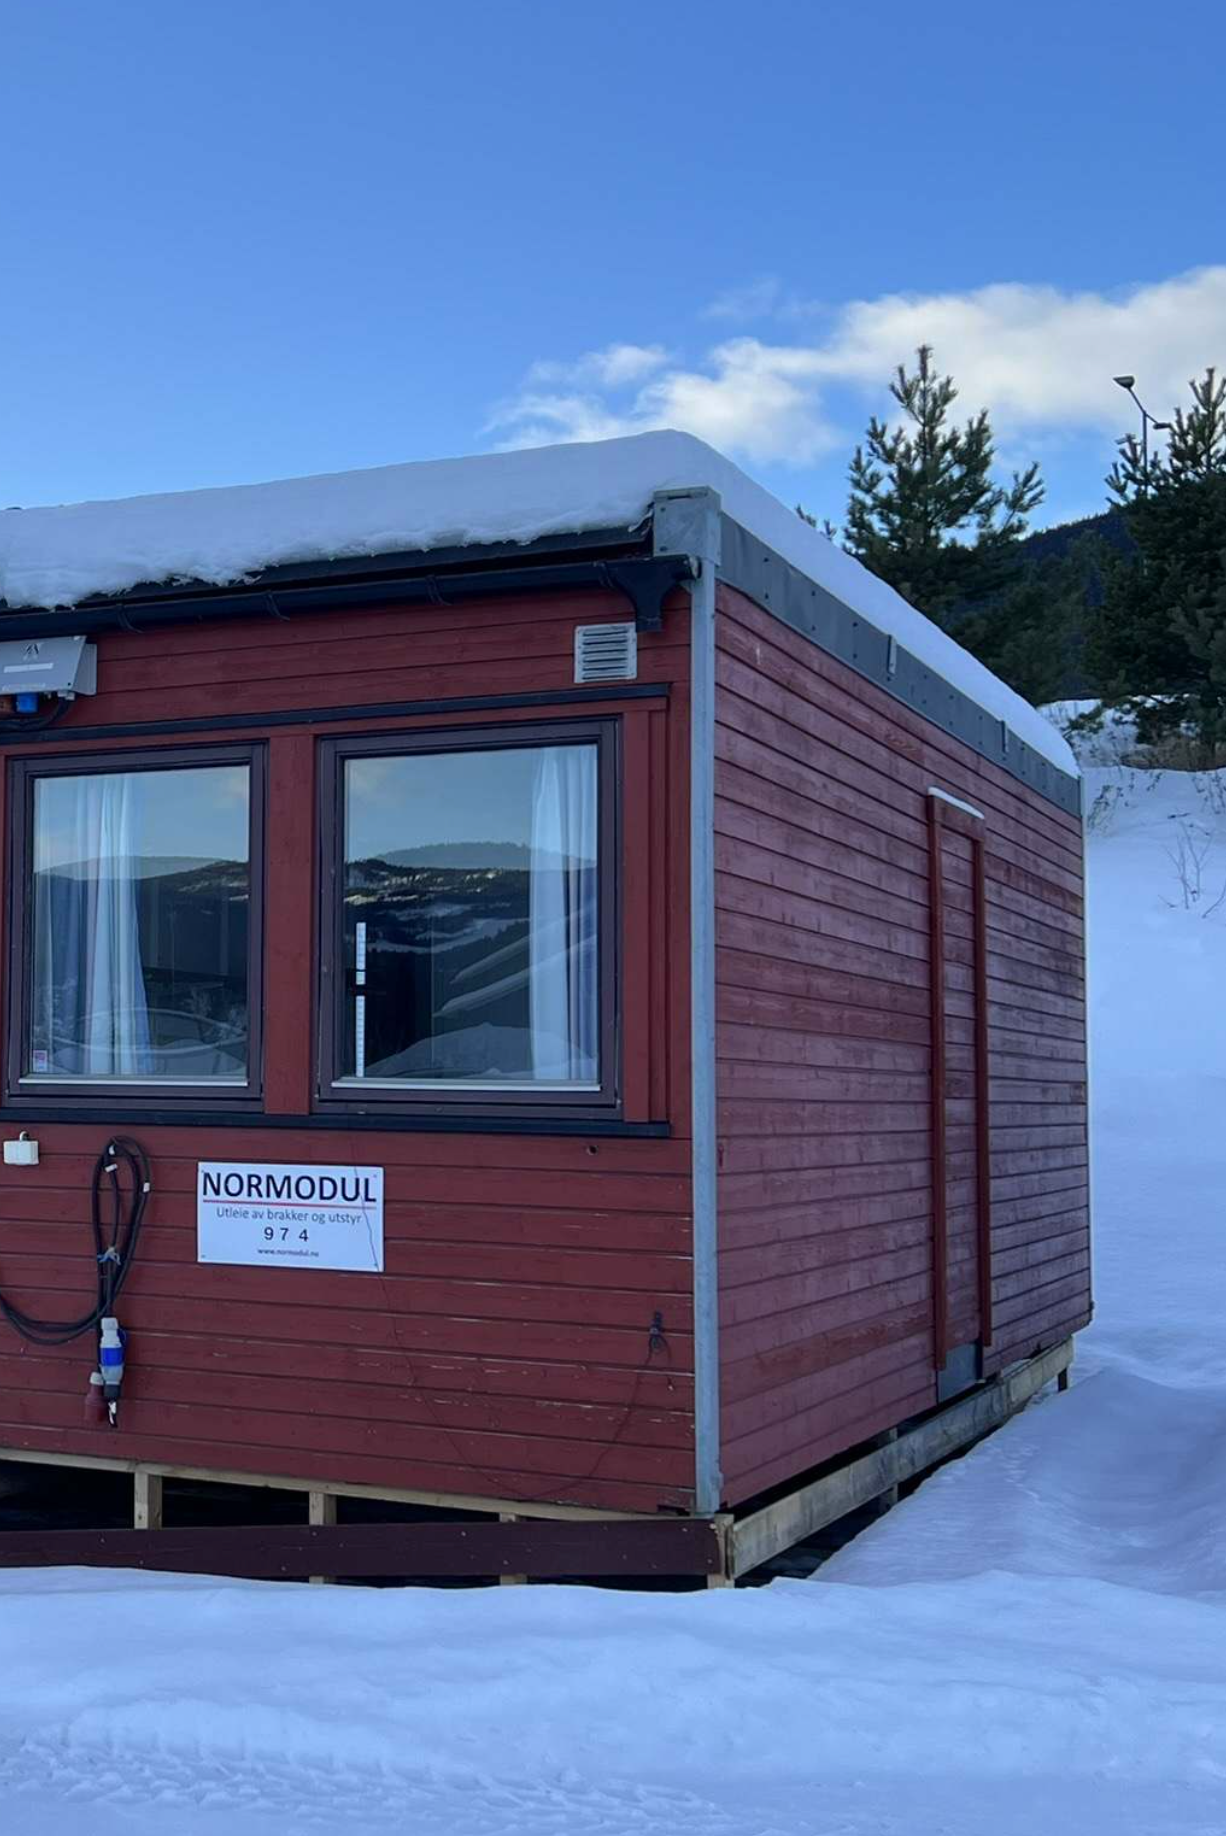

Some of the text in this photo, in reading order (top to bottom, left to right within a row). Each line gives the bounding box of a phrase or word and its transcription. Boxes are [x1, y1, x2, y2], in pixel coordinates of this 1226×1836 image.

[202, 1172, 377, 1203] NORMODUL
[216, 1207, 362, 1226] Utleie av brakker og utstyr
